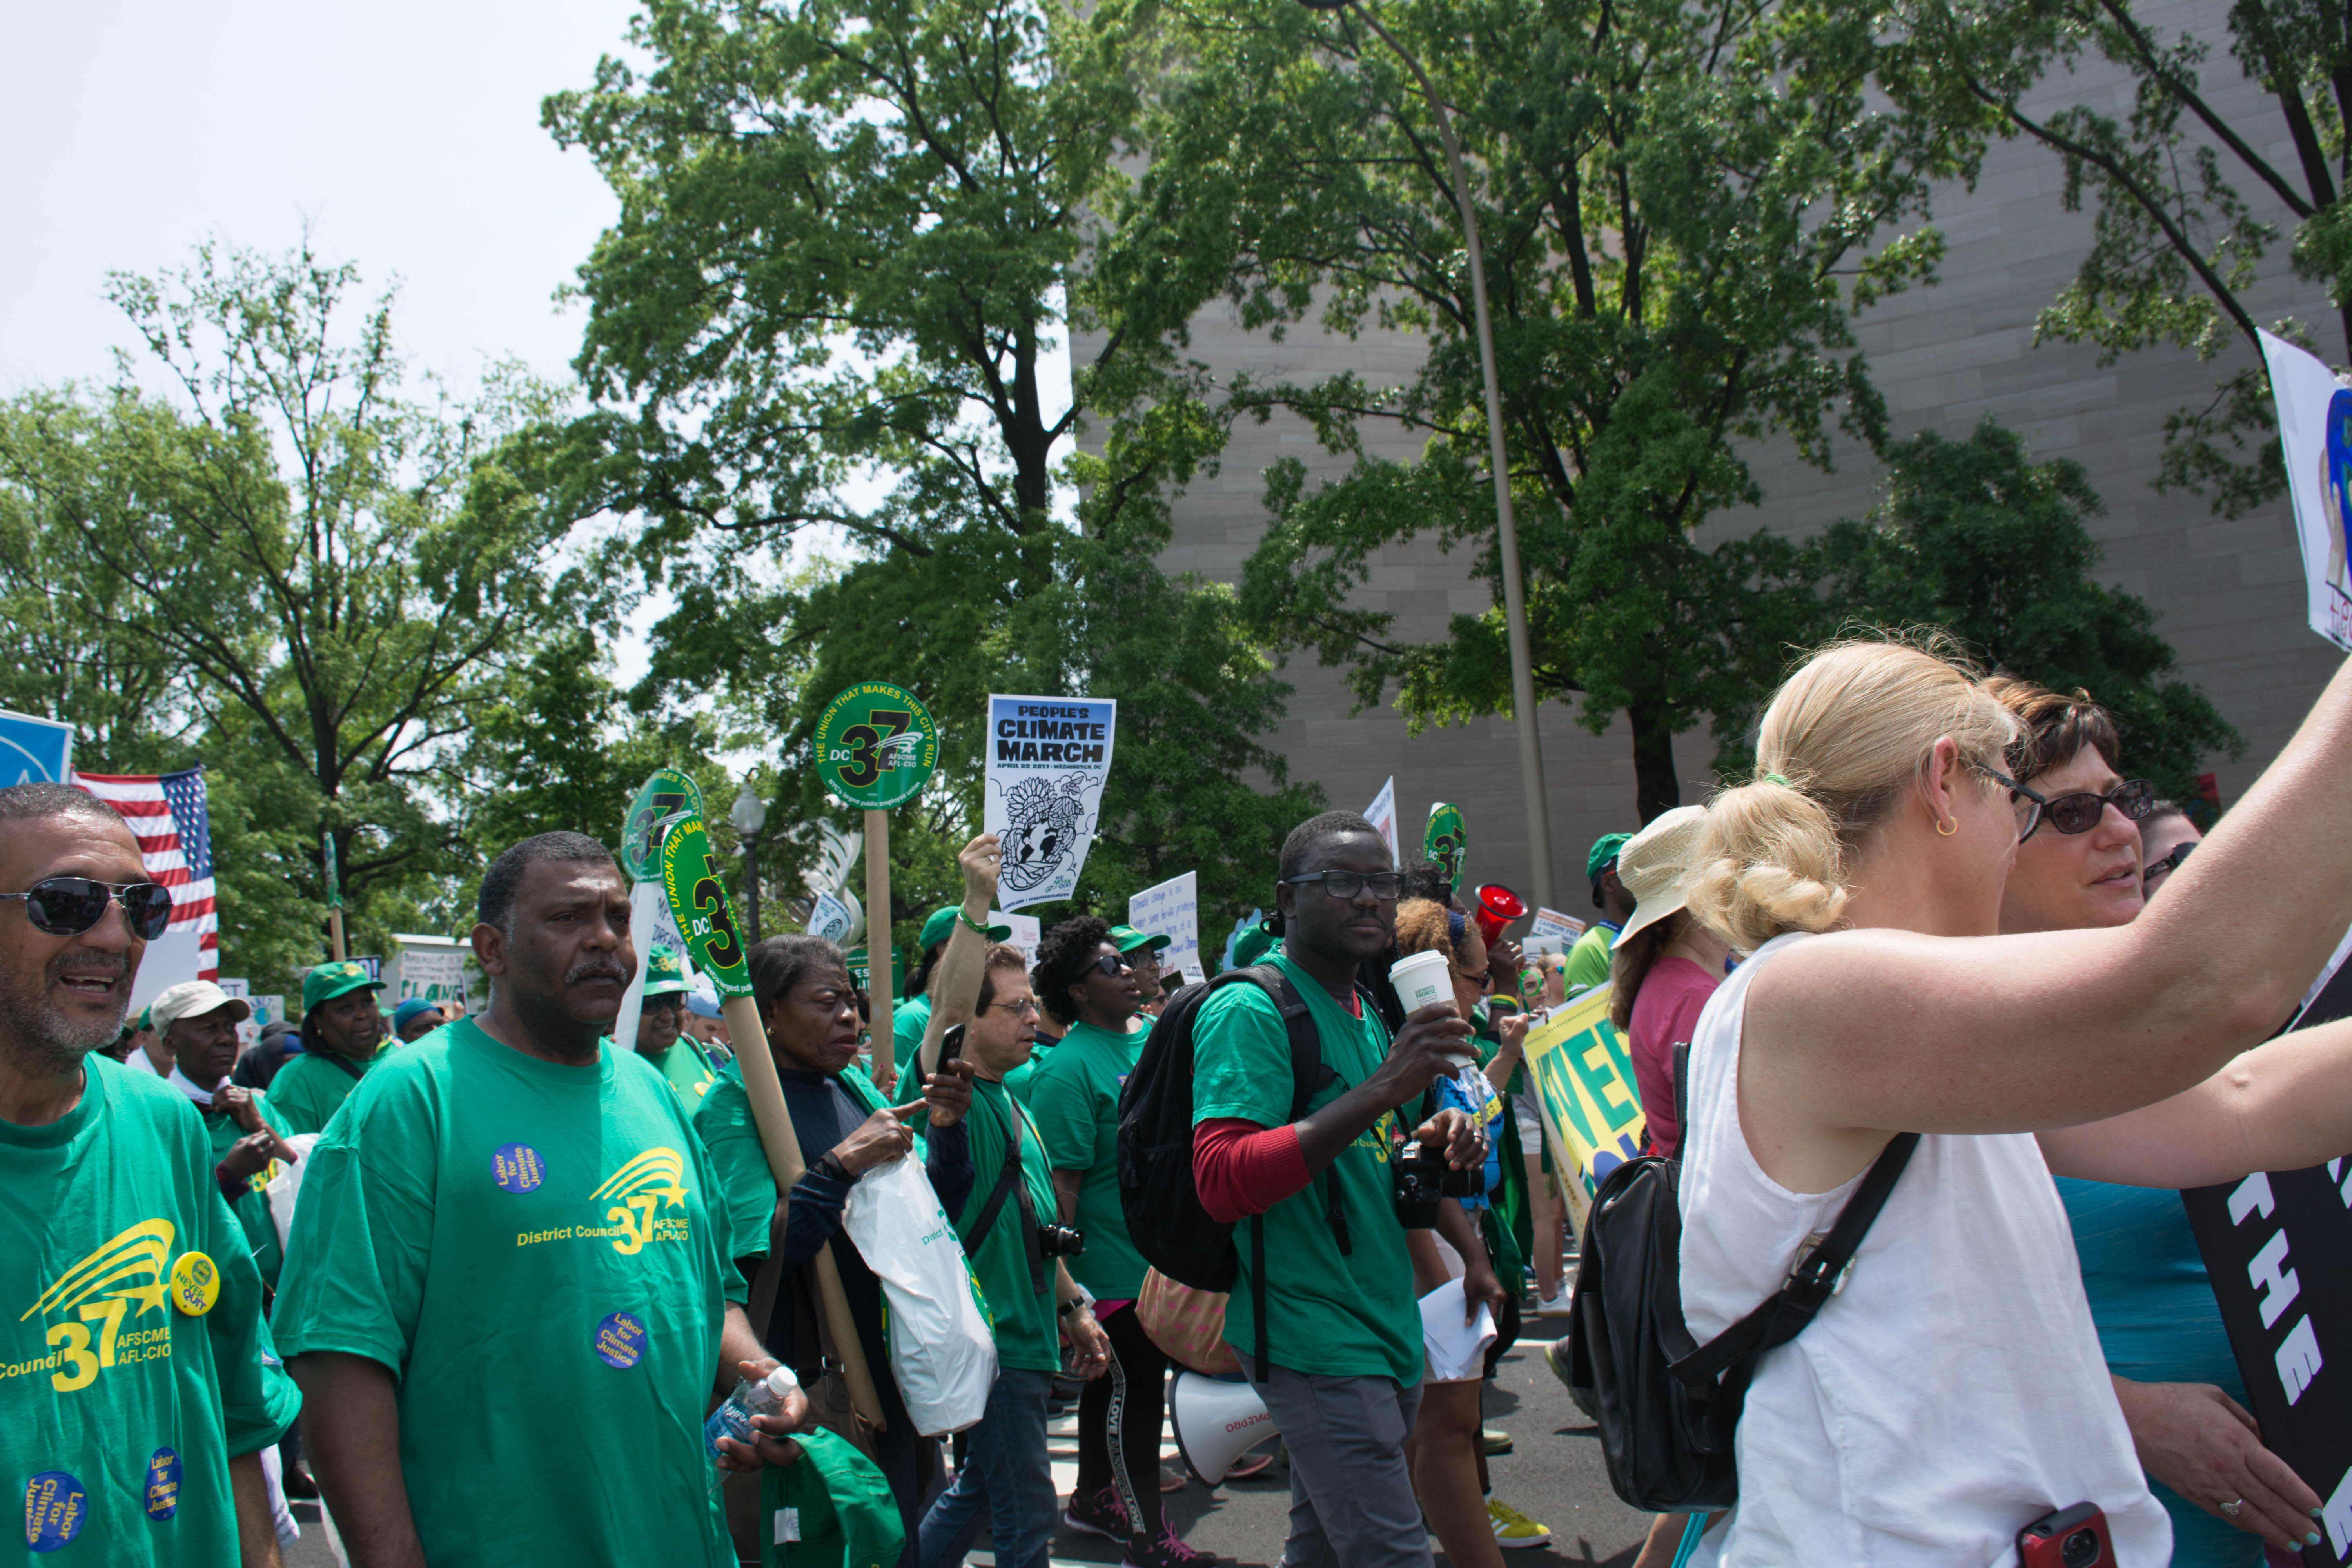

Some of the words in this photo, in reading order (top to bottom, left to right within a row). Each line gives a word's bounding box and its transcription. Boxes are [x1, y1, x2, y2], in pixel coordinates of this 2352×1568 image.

[835, 688, 859, 707] THAT
[862, 685, 901, 699] MAKES
[903, 695, 923, 716] THIS
[1018, 706, 1089, 719] PEOPLE'S
[817, 706, 837, 739] UNION
[920, 717, 934, 741] CITY
[998, 719, 1105, 740] CLIMATE
[816, 743, 826, 764] THE
[829, 749, 850, 760] DC
[837, 709, 911, 788] 37
[922, 744, 934, 767] RUN
[997, 740, 1103, 763] MARCH
[680, 779, 695, 797] THIS
[691, 797, 700, 816] CITY
[843, 792, 860, 804] largest
[879, 794, 906, 806] employee
[906, 781, 920, 795] union
[1436, 806, 1450, 818] THAT
[682, 821, 706, 835] MAK
[665, 829, 684, 858] THAT
[1428, 850, 1438, 860] DC
[664, 860, 680, 907] UNION
[675, 913, 693, 946] THE
[692, 917, 710, 936] DC
[1539, 919, 1565, 932] CARBON
[1566, 929, 1579, 937] FEE
[720, 979, 740, 992] largest
[1416, 988, 1436, 999] PROMISE
[495, 1154, 509, 1186] Labor
[508, 1161, 517, 1176] for
[515, 1148, 530, 1188] Climate
[525, 1149, 541, 1185] Justice
[517, 1227, 572, 1247] District
[575, 1225, 621, 1237] Council
[606, 1194, 658, 1255] 37
[176, 1270, 205, 1300] NEVER
[183, 1289, 207, 1310] QUIT
[614, 1312, 644, 1336] Labor
[617, 1327, 632, 1341] for
[46, 1298, 127, 1392] 37
[116, 1327, 171, 1349] AFSCME
[601, 1329, 638, 1357] Climate
[118, 1343, 171, 1365] AFL-CIO
[597, 1340, 633, 1366] Justice
[1226, 1412, 1271, 1432] PYLEPRO
[151, 1455, 174, 1470] Labor
[1109, 1396, 1121, 1434] LOVE
[1126, 1497, 1142, 1533] LOVE
[158, 1470, 168, 1482] for
[26, 1478, 42, 1536] Justi
[31, 1479, 57, 1543] Climate
[49, 1501, 65, 1525] for
[60, 1492, 84, 1540] Labor
